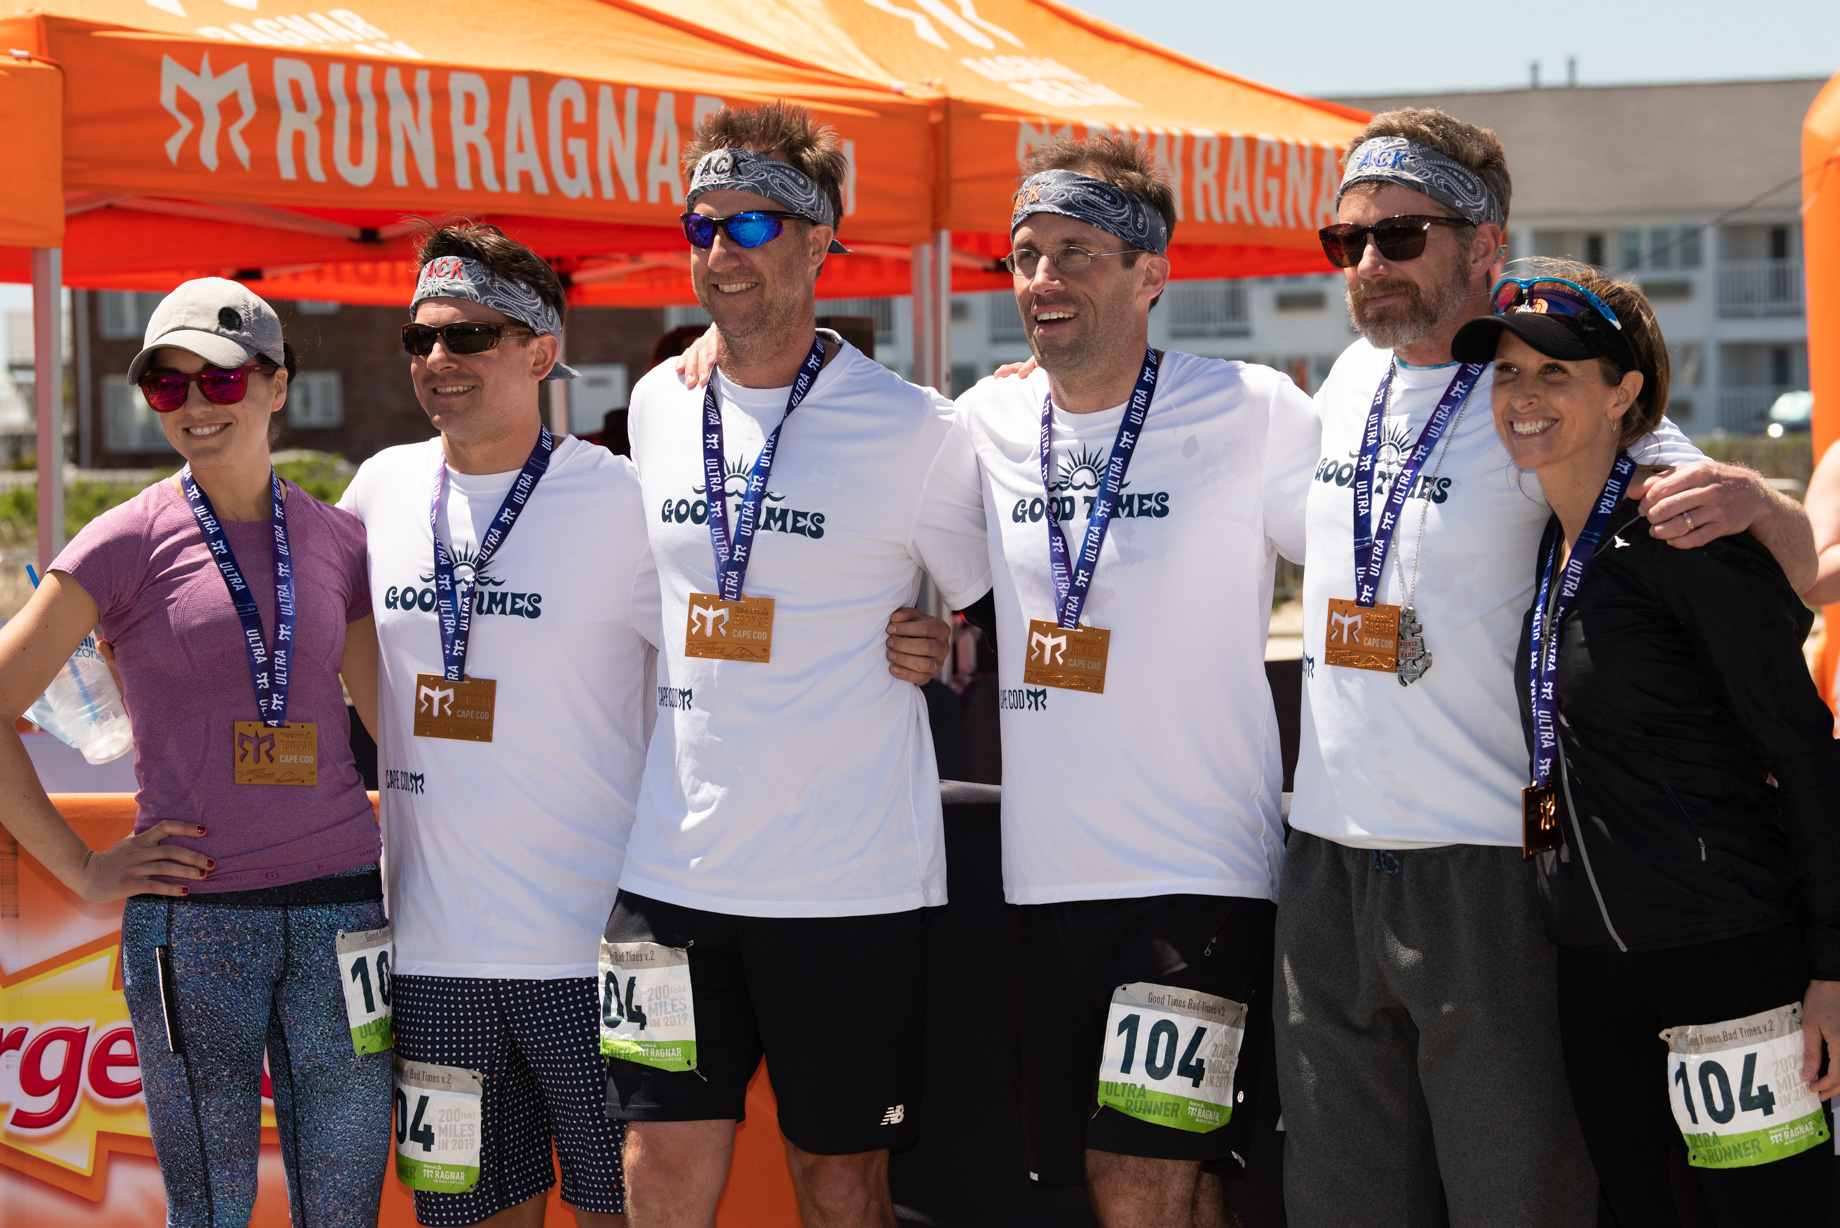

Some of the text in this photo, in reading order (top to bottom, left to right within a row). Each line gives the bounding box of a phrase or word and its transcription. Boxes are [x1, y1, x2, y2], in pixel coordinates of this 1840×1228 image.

[448, 71, 727, 206] RAGNA
[1357, 150, 1409, 171] ACK
[424, 258, 466, 280] ACK
[791, 372, 811, 407] ULTRA
[1130, 389, 1147, 425] ULTRA
[760, 433, 776, 467] ULTRA
[1356, 413, 1378, 516] ULTRA ULTRA
[513, 473, 535, 505] ULTRA
[705, 458, 723, 492] ULTRA
[1107, 457, 1124, 493] ULTRA
[1314, 458, 1356, 489] GOO
[1083, 492, 1170, 520] TMES
[1369, 403, 1451, 577] ULTRA ULTRA ULTRA
[1599, 479, 1622, 515] ULTRA
[661, 499, 711, 526] GOO
[740, 501, 755, 536] ULTRA
[1042, 424, 1070, 598] ULTRA ULTRA
[274, 524, 290, 556] ULTRA
[479, 527, 502, 561] ULTRA
[712, 527, 731, 562] ULTRA
[1085, 526, 1101, 562] ULTRA
[193, 504, 268, 664] ULTRA ULTRA ULTRA
[1561, 559, 1584, 598] ULTRA
[277, 584, 293, 617] ULTRA
[385, 586, 542, 619] GOO IMES
[459, 597, 470, 631] ULTRA
[439, 600, 458, 634] ULTRA
[1532, 604, 1543, 641] ULTRA
[732, 629, 768, 640] CAPE COD
[1363, 637, 1394, 649] CAPE COD
[274, 650, 287, 686] ULTRA
[1068, 658, 1102, 671] CAPE COD
[456, 709, 490, 720] CAPE COD
[1008, 689, 1025, 710] COD
[1538, 709, 1556, 749] ULTRA
[279, 754, 314, 764] CAPE COD
[648, 997, 688, 1018] MILES
[1147, 992, 1165, 1005] Good
[1167, 995, 1186, 1008] Times
[1187, 998, 1200, 1011] Bad
[649, 1013, 688, 1029] IN 2019
[1700, 1034, 1722, 1046] Times
[1723, 1030, 1738, 1042] Bad
[1739, 1025, 1762, 1039] Times
[650, 1048, 682, 1058] RAGNAR
[1117, 1013, 1208, 1088] 104
[409, 1069, 421, 1081] Bad
[422, 1070, 440, 1083] Times
[1105, 1081, 1147, 1099] ULTRA
[1675, 1052, 1776, 1125] 104
[1775, 1071, 1802, 1095] MIL
[1125, 1099, 1180, 1118] RUNNER
[1197, 1108, 1220, 1122] RAGNAR
[438, 1123, 475, 1138] MILES
[438, 1138, 475, 1150] IN 2019
[1784, 1121, 1815, 1140] RAGNAR
[1706, 1138, 1762, 1164] RUNNER
[435, 1170, 465, 1181] RAGNAR
